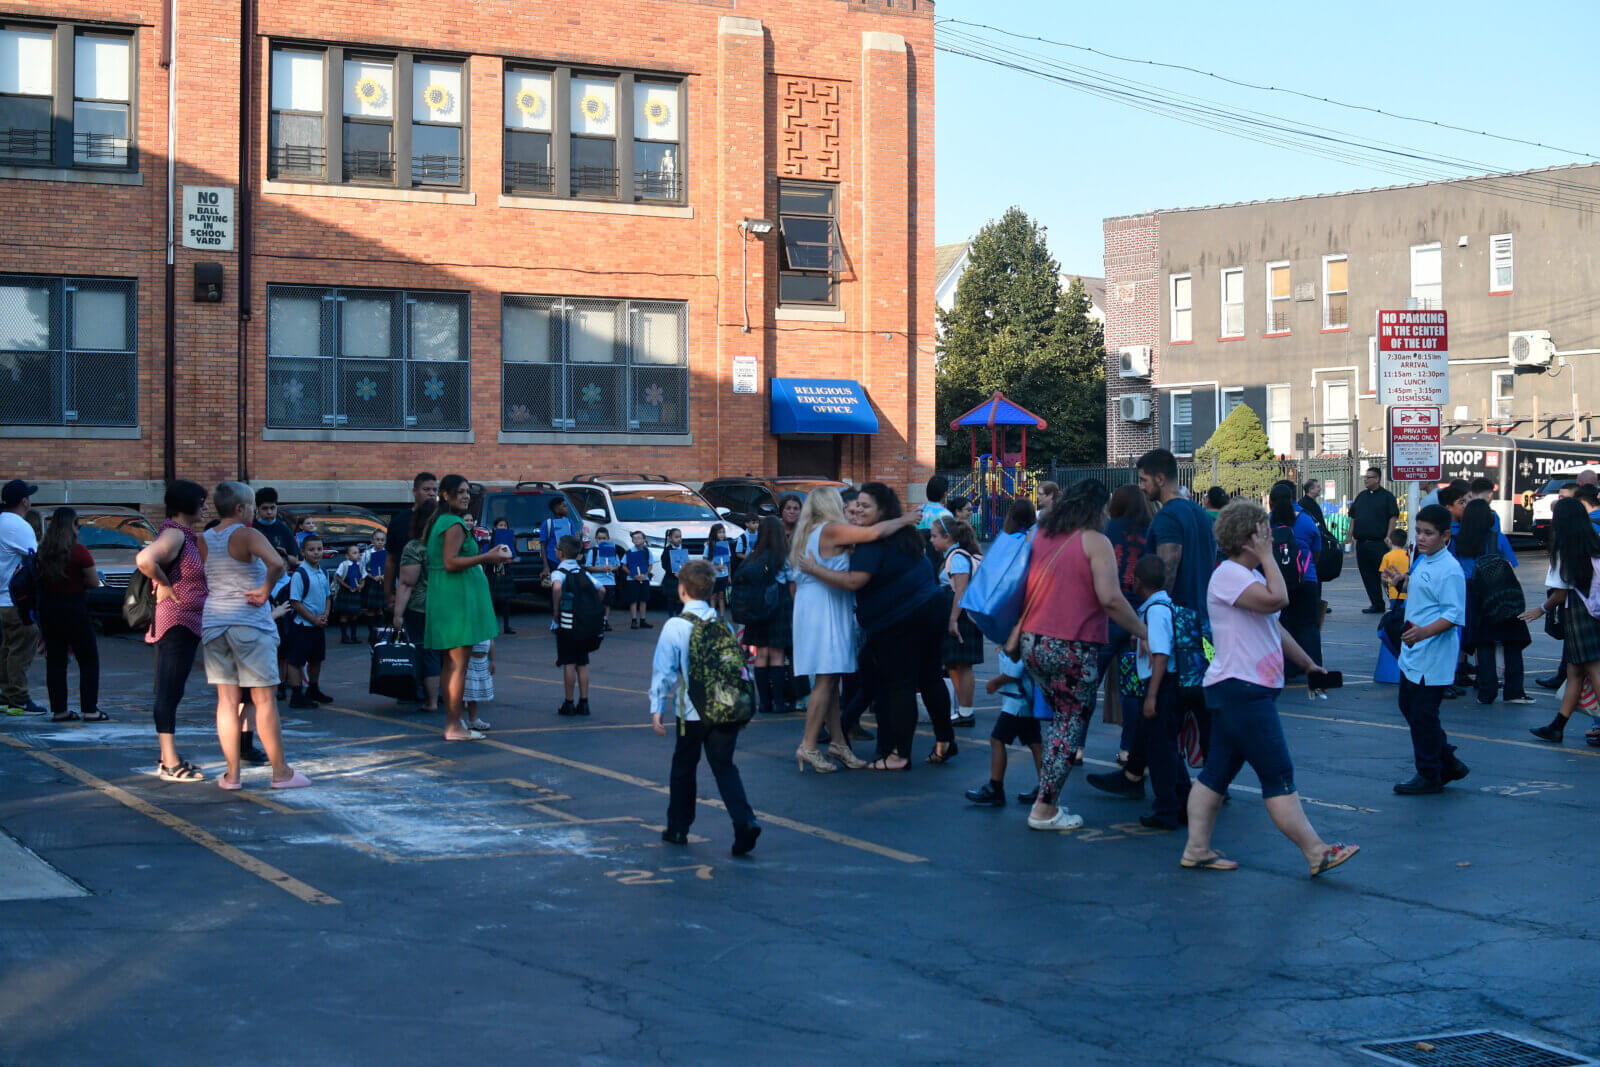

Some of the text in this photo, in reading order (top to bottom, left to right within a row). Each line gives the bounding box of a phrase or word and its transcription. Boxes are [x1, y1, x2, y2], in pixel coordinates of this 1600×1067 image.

[198, 191, 219, 204] NO
[197, 207, 219, 215] BALL
[189, 214, 228, 223] PLAYING
[203, 222, 213, 230] IN
[190, 229, 226, 238] SCHOOL
[196, 237, 221, 245] YARD
[1382, 312, 1445, 324] NO PARKING
[1382, 325, 1445, 337] IN THE CENTER
[1391, 338, 1438, 349] OF THE LOT
[1418, 371, 1445, 379] 12:30pm
[794, 387, 853, 395] RELIGIOUS
[796, 396, 859, 404] EDUCATION
[812, 405, 854, 413] OFFICE
[1440, 450, 1483, 465] TROOP
